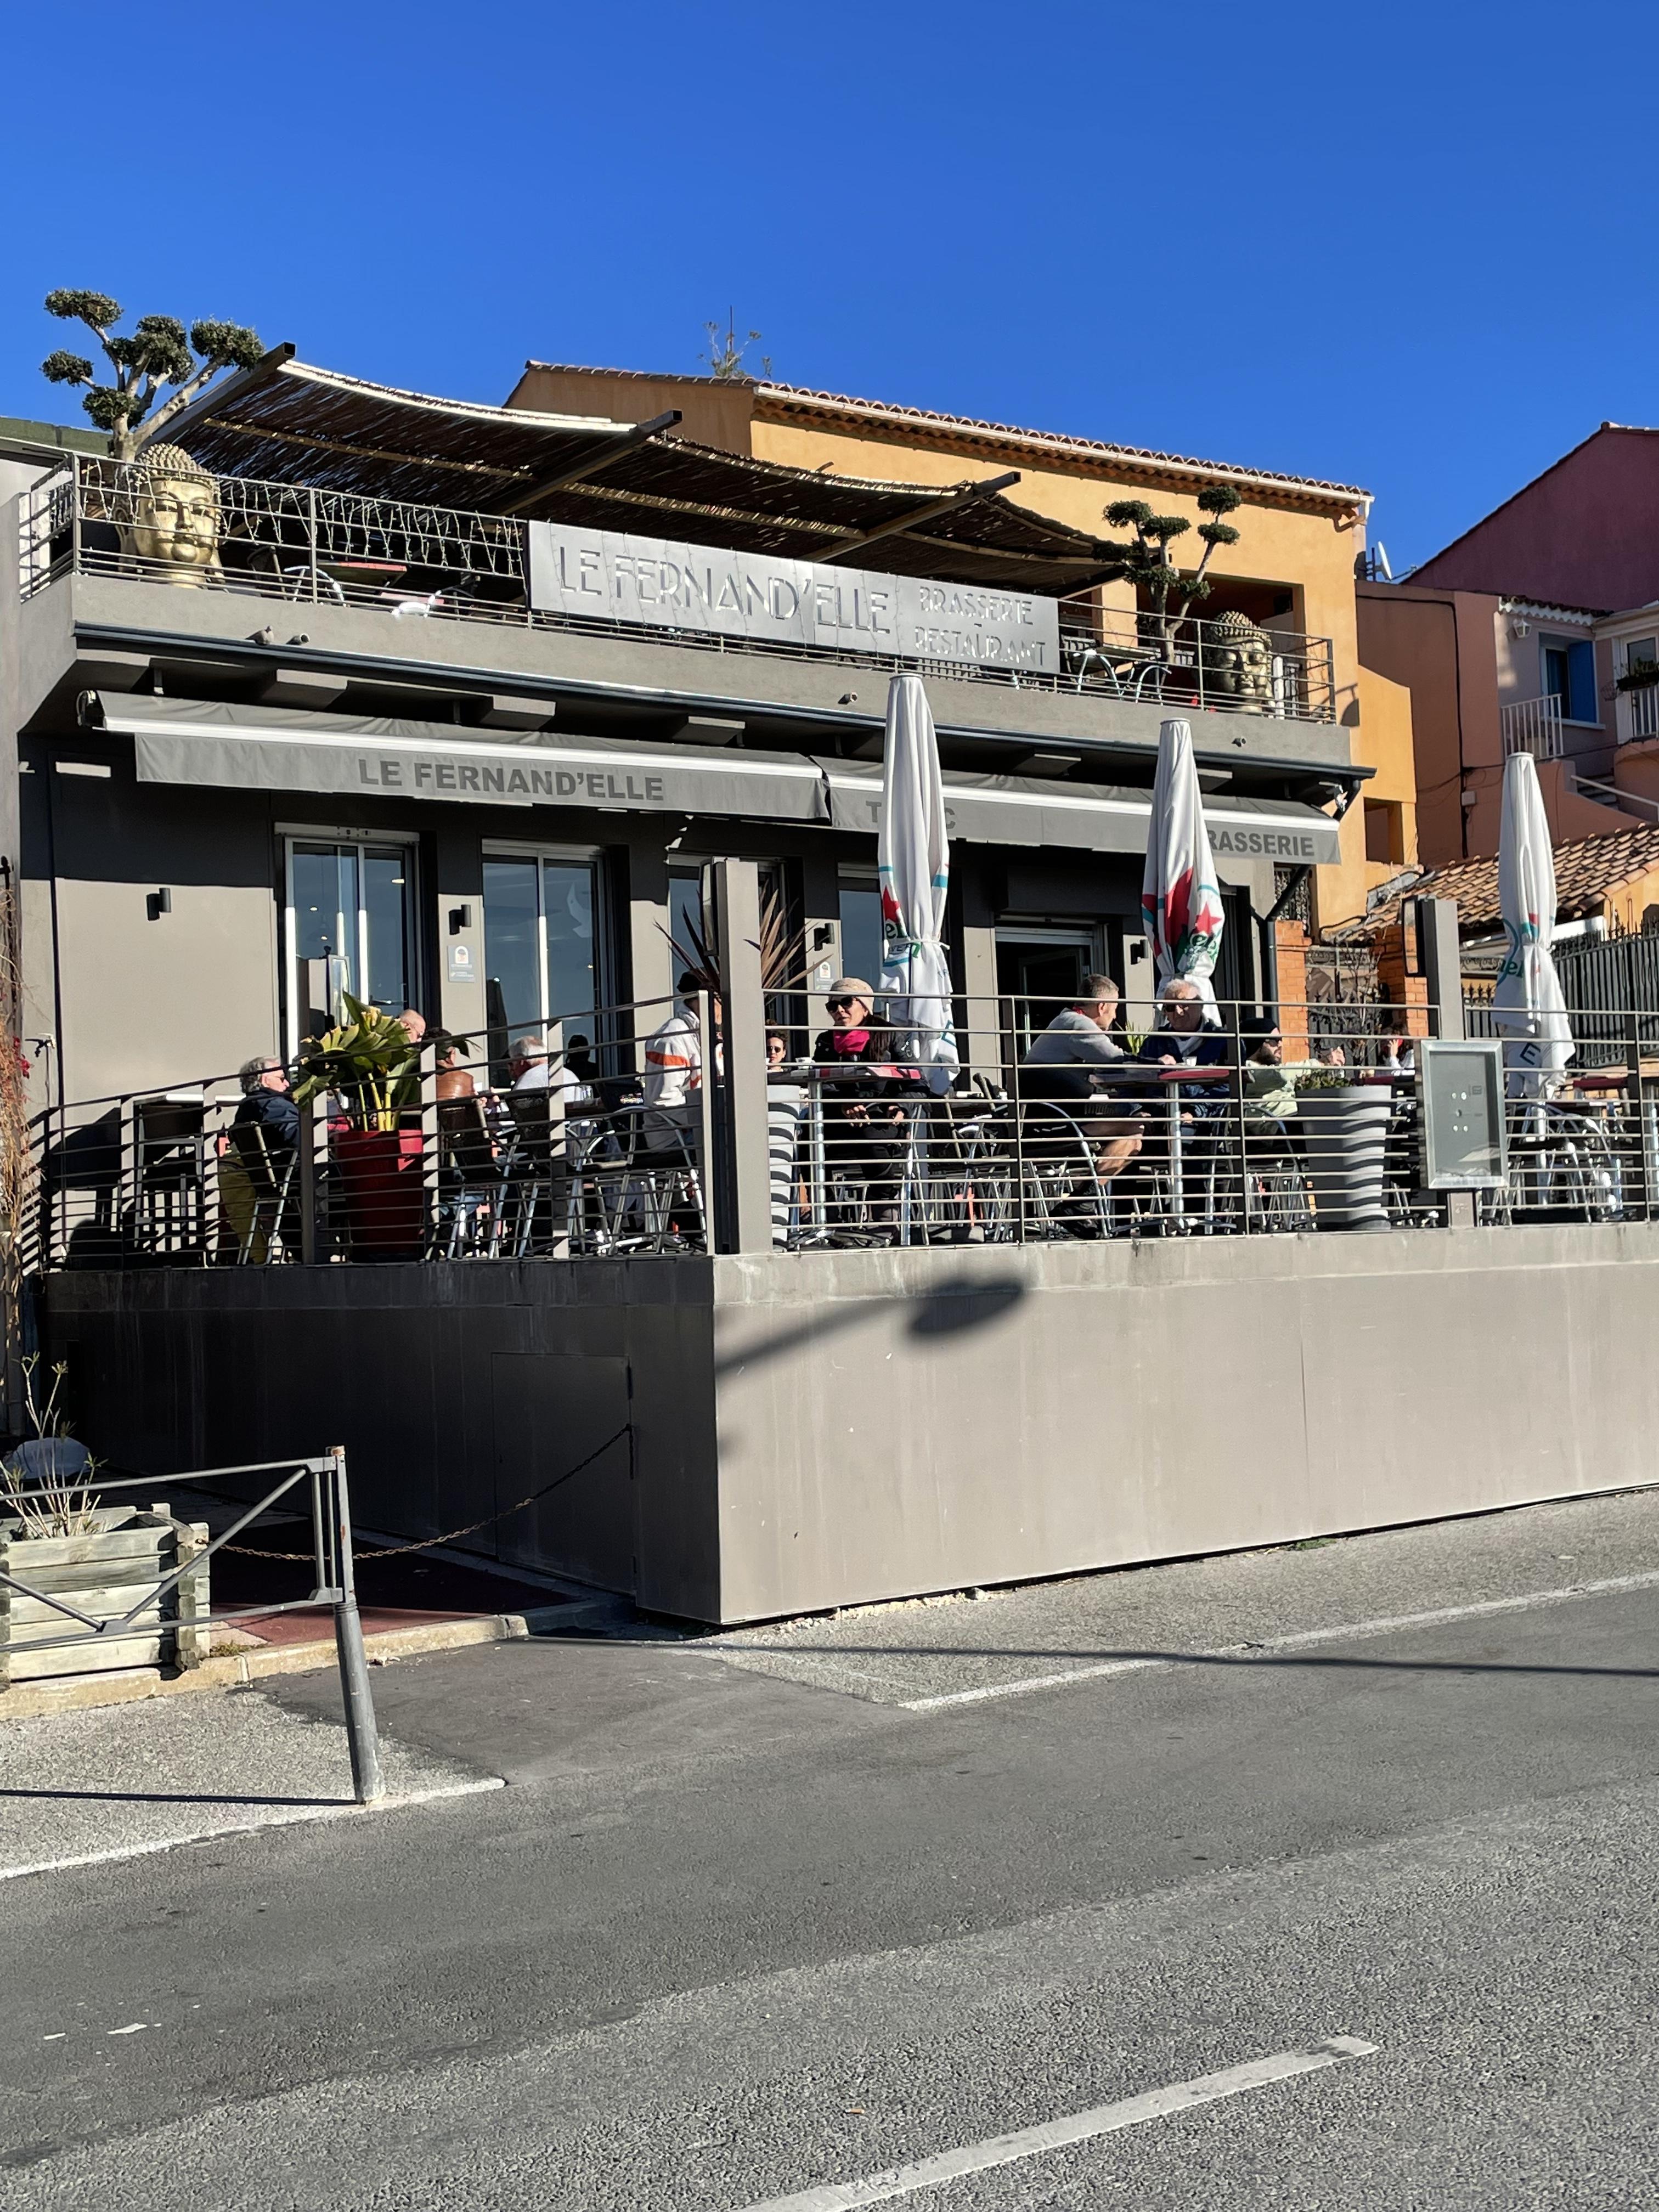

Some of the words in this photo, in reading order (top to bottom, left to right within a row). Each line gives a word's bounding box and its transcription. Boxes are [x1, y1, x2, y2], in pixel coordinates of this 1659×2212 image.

[559, 546, 602, 595] LE
[615, 554, 890, 634] FERNAND'ELLE
[919, 586, 1034, 625] BRASSERIE
[915, 626, 1046, 666] RESTAURANT
[358, 759, 403, 786] LE
[414, 762, 664, 801] FERNAND'ELLE
[1207, 829, 1315, 856] RASSERIE
